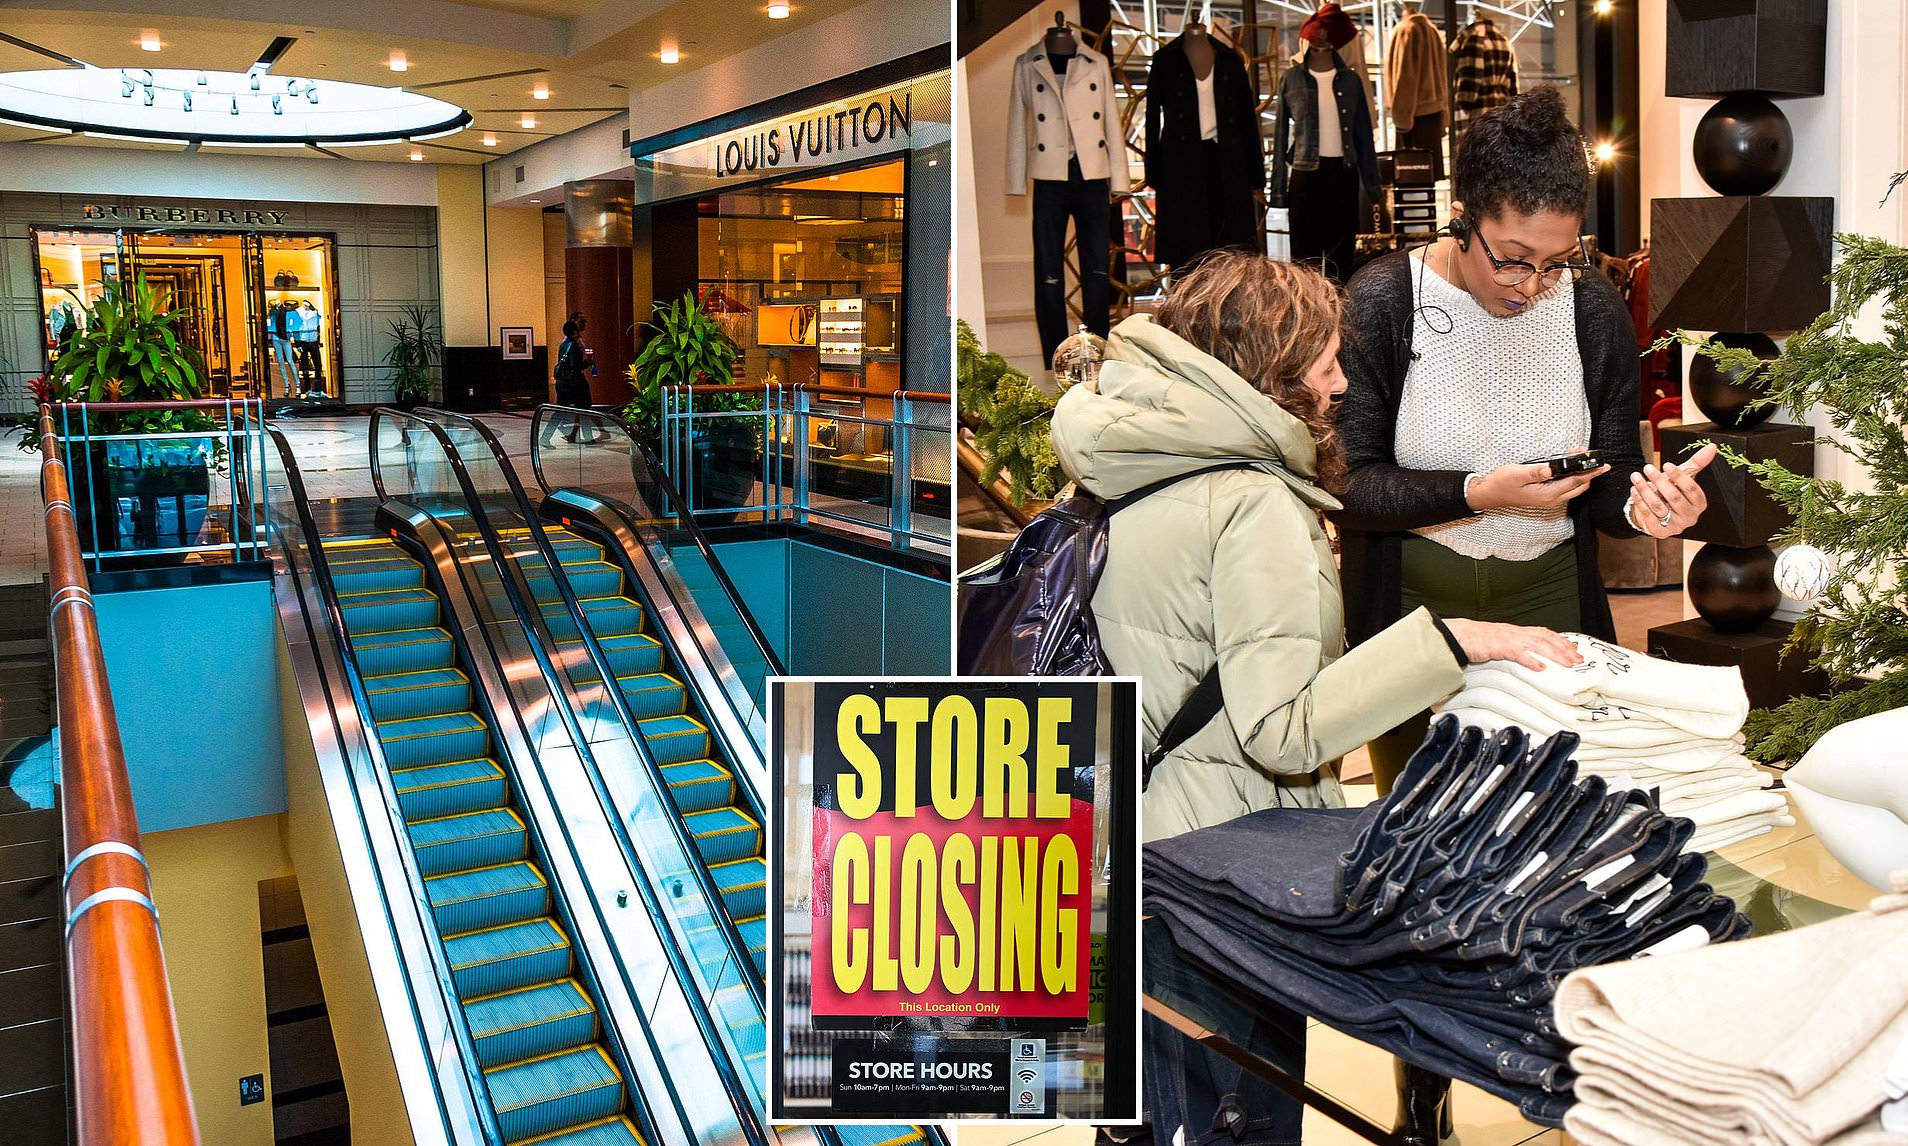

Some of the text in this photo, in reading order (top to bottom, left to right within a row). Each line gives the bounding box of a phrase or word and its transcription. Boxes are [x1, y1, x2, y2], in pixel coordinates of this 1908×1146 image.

[716, 93, 912, 178] LOUIS VUITTON
[82, 204, 289, 225] BURBERRY
[836, 694, 1073, 819] STORE
[831, 832, 1080, 995] CLOSING
[898, 1002, 1000, 1014] This Location Only
[849, 1062, 993, 1079] STORE HOURS
[839, 1083, 1005, 1093] Sun 10am-7pm Mon-Fri 9am-9pm Sat 9am-9pm
